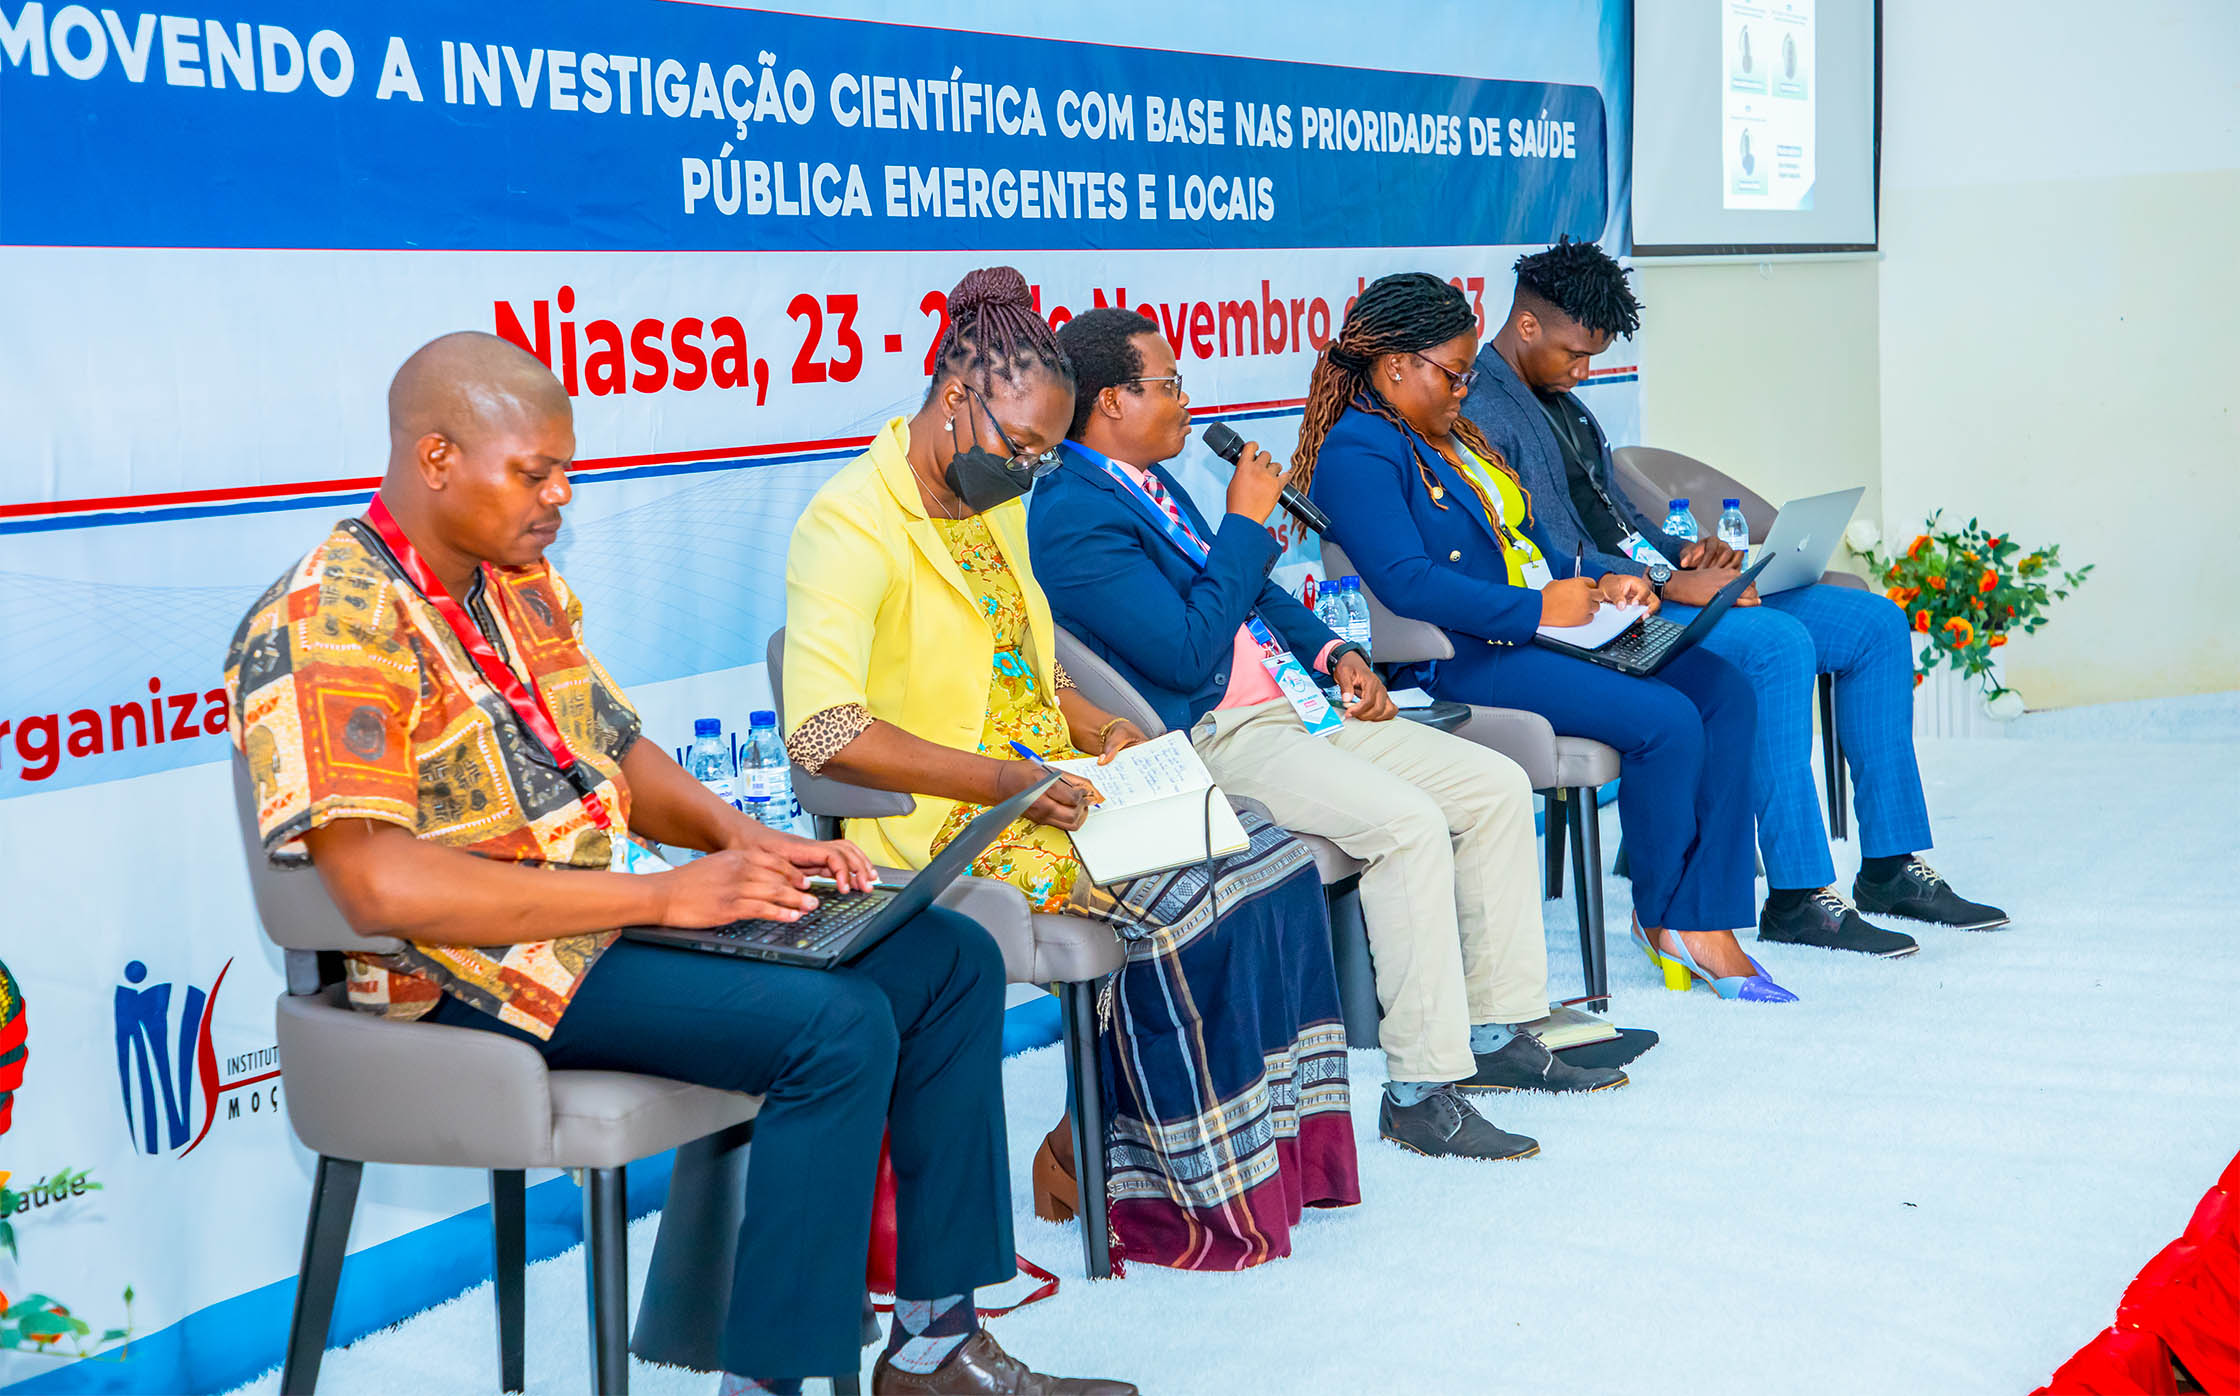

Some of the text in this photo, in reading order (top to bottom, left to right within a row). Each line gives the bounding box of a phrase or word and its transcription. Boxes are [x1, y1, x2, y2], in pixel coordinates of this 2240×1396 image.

[0, 1, 1576, 158] MOVENDO A INVESTIGAÇÃO CIENTÍFICA COM BASE NAS PRIORIDADES DE SAÚDE
[682, 141, 1275, 222] PÚBLICA EMERGENTES E LOCAIS
[786, 293, 863, 384] 23
[920, 290, 952, 376] 2
[1093, 279, 1330, 361] vembro
